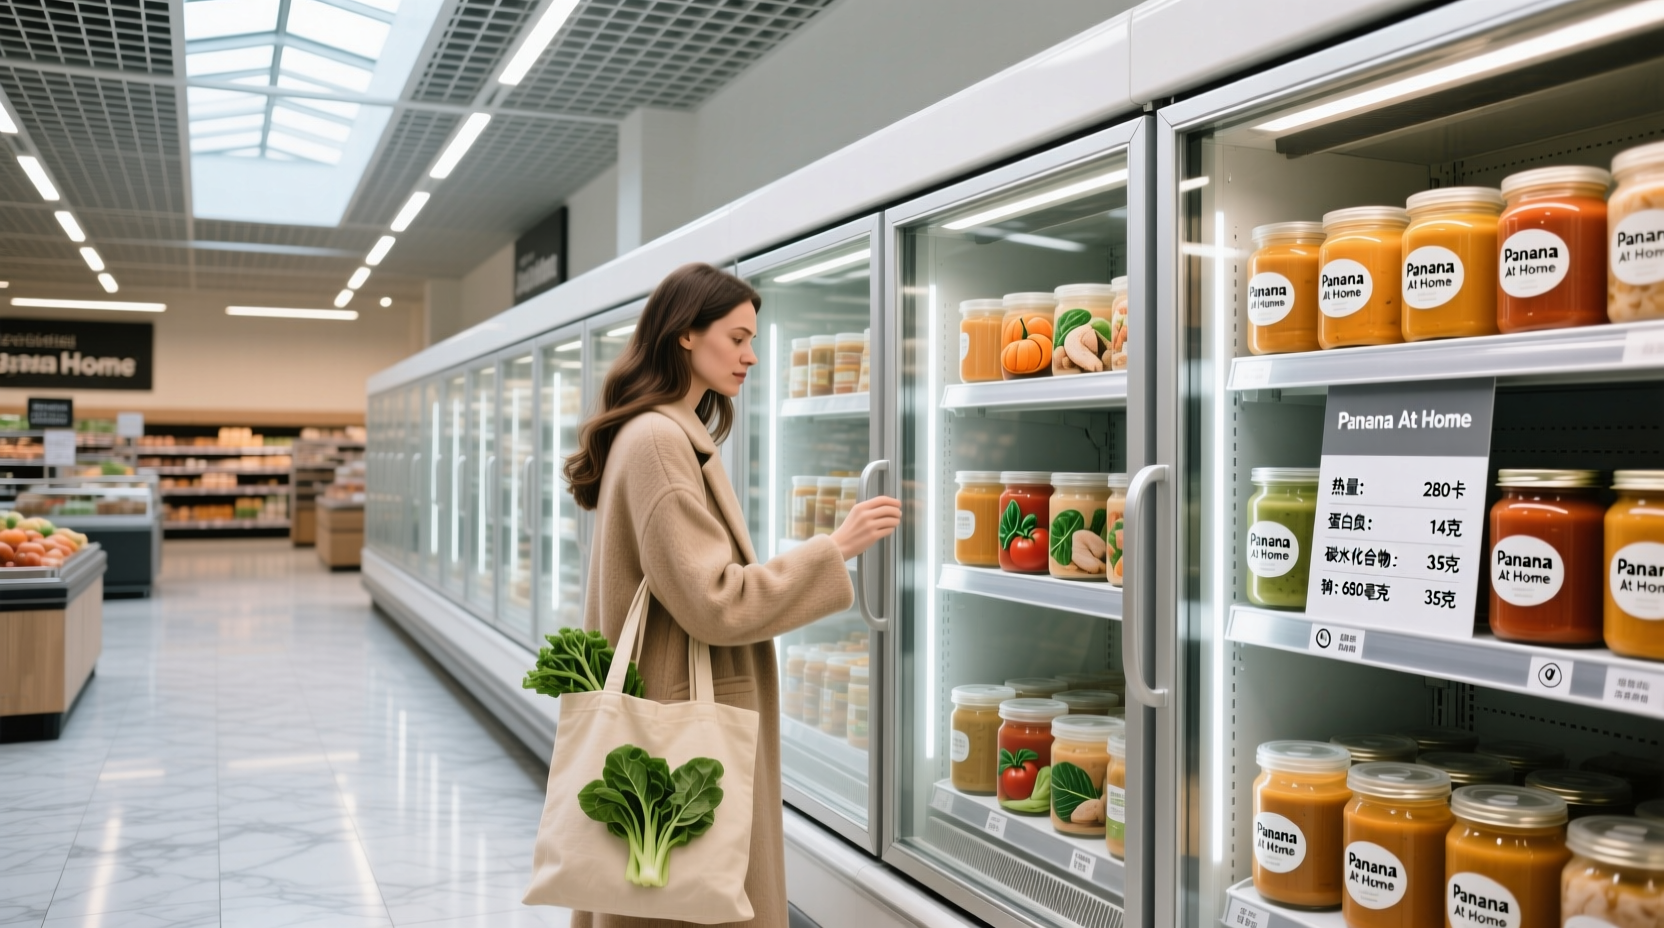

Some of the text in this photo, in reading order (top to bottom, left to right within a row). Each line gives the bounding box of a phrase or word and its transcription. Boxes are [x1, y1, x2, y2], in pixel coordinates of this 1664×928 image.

[1505, 247, 1558, 263] Panana
[1406, 262, 1455, 279] Panana
[1505, 262, 1556, 278] At Home
[1322, 273, 1364, 288] Panana
[1407, 278, 1452, 291] At Home
[1332, 288, 1362, 300] Home
[60, 351, 136, 377] Home
[1337, 409, 1472, 430] Panana At Home
[1422, 479, 1467, 499] 280卡
[1430, 518, 1463, 538] 14克
[1250, 532, 1291, 549] Panana
[1261, 548, 1290, 561] Home
[1426, 553, 1461, 574] 35克
[1497, 549, 1553, 570] Panana
[1498, 569, 1551, 585] At Home
[1620, 578, 1633, 592] At
[1424, 588, 1457, 610] 35克
[1257, 821, 1298, 845] Panana
[1348, 851, 1398, 879] Panana
[1349, 869, 1360, 884] At
[1453, 883, 1509, 915] Panana
[1453, 904, 1508, 928] At Home
